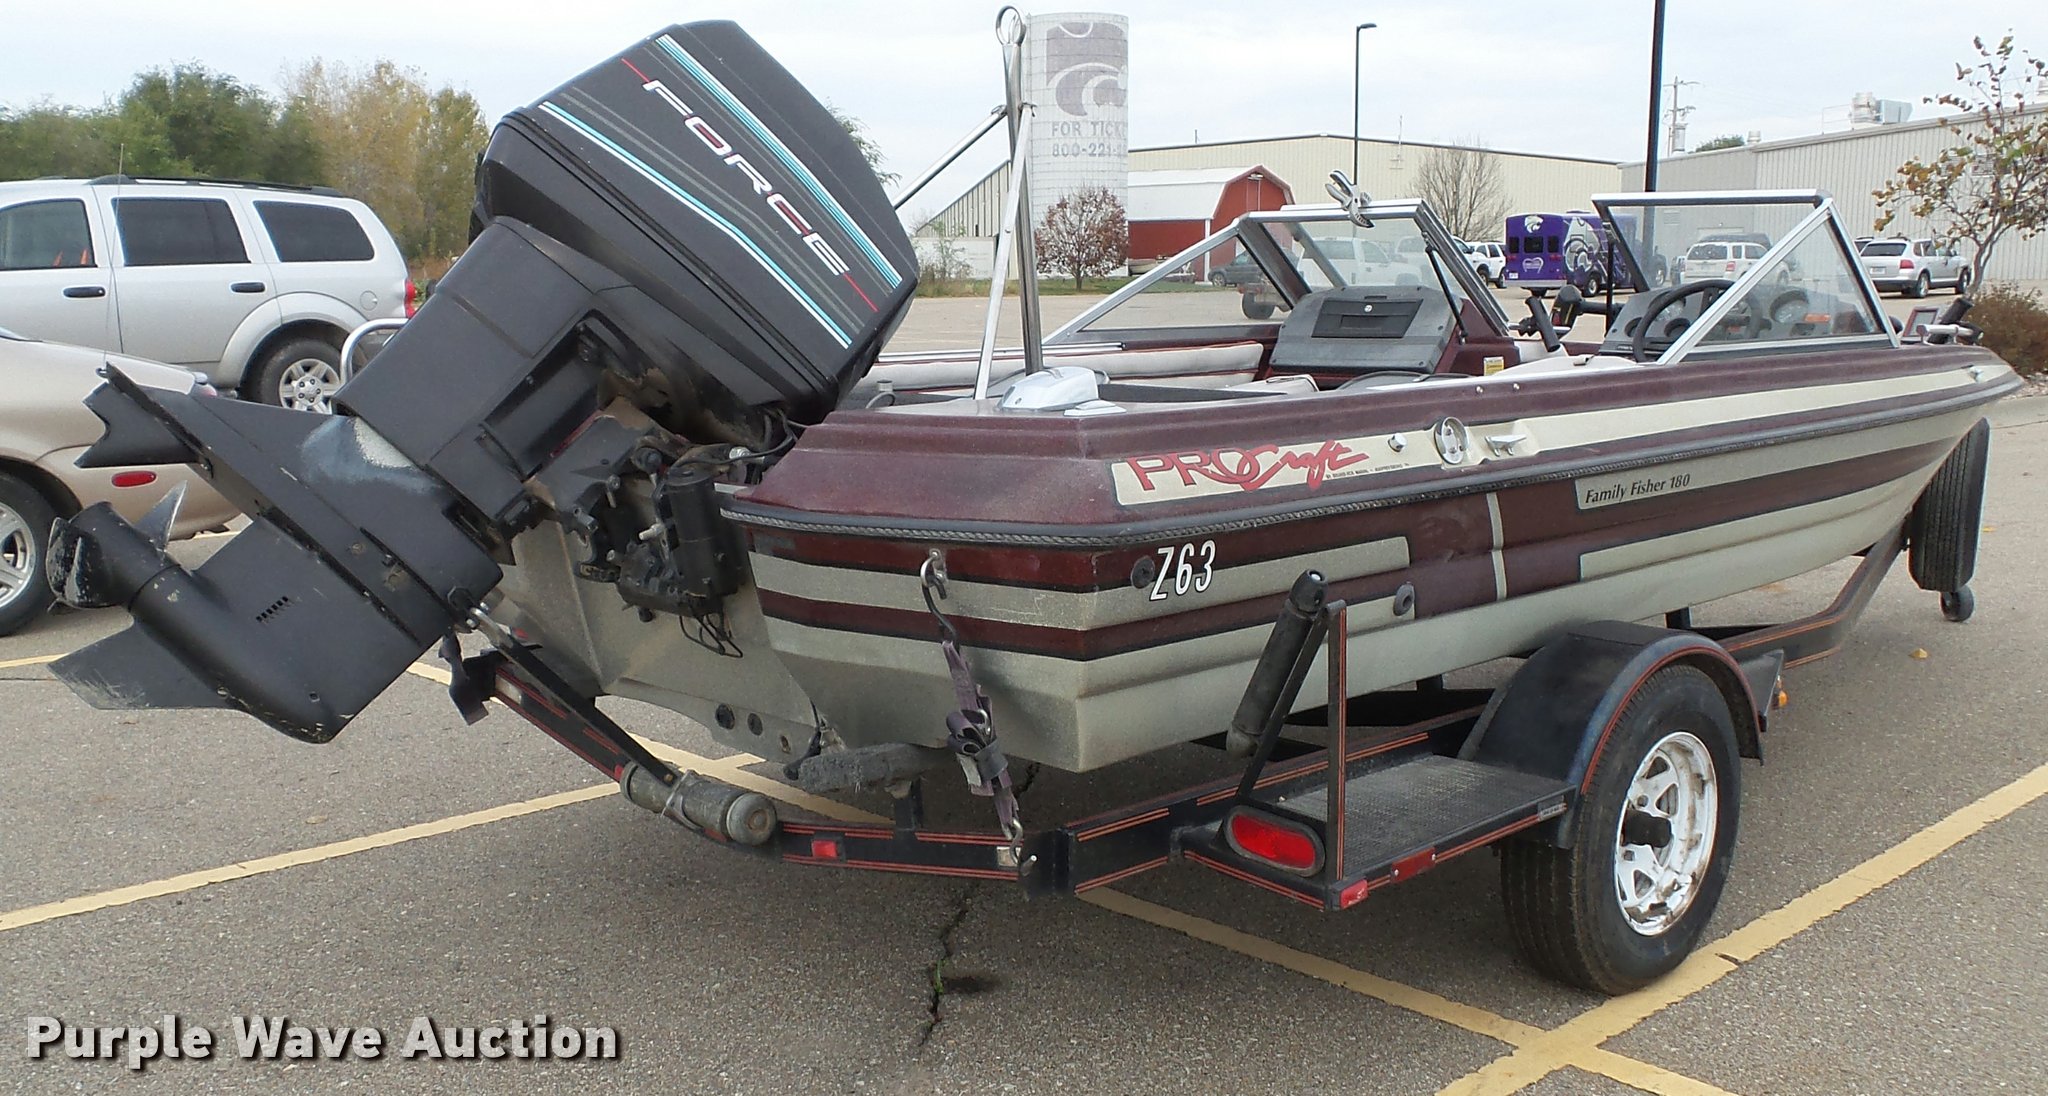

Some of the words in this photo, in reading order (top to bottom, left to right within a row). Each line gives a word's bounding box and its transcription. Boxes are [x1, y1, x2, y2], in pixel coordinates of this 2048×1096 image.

[1052, 121, 1081, 137] FOR
[642, 80, 850, 276] FORCE
[1585, 484, 1627, 504] Family
[1630, 479, 1666, 496] Fisher
[1670, 473, 1691, 489] 180
[1149, 539, 1217, 602] Z63
